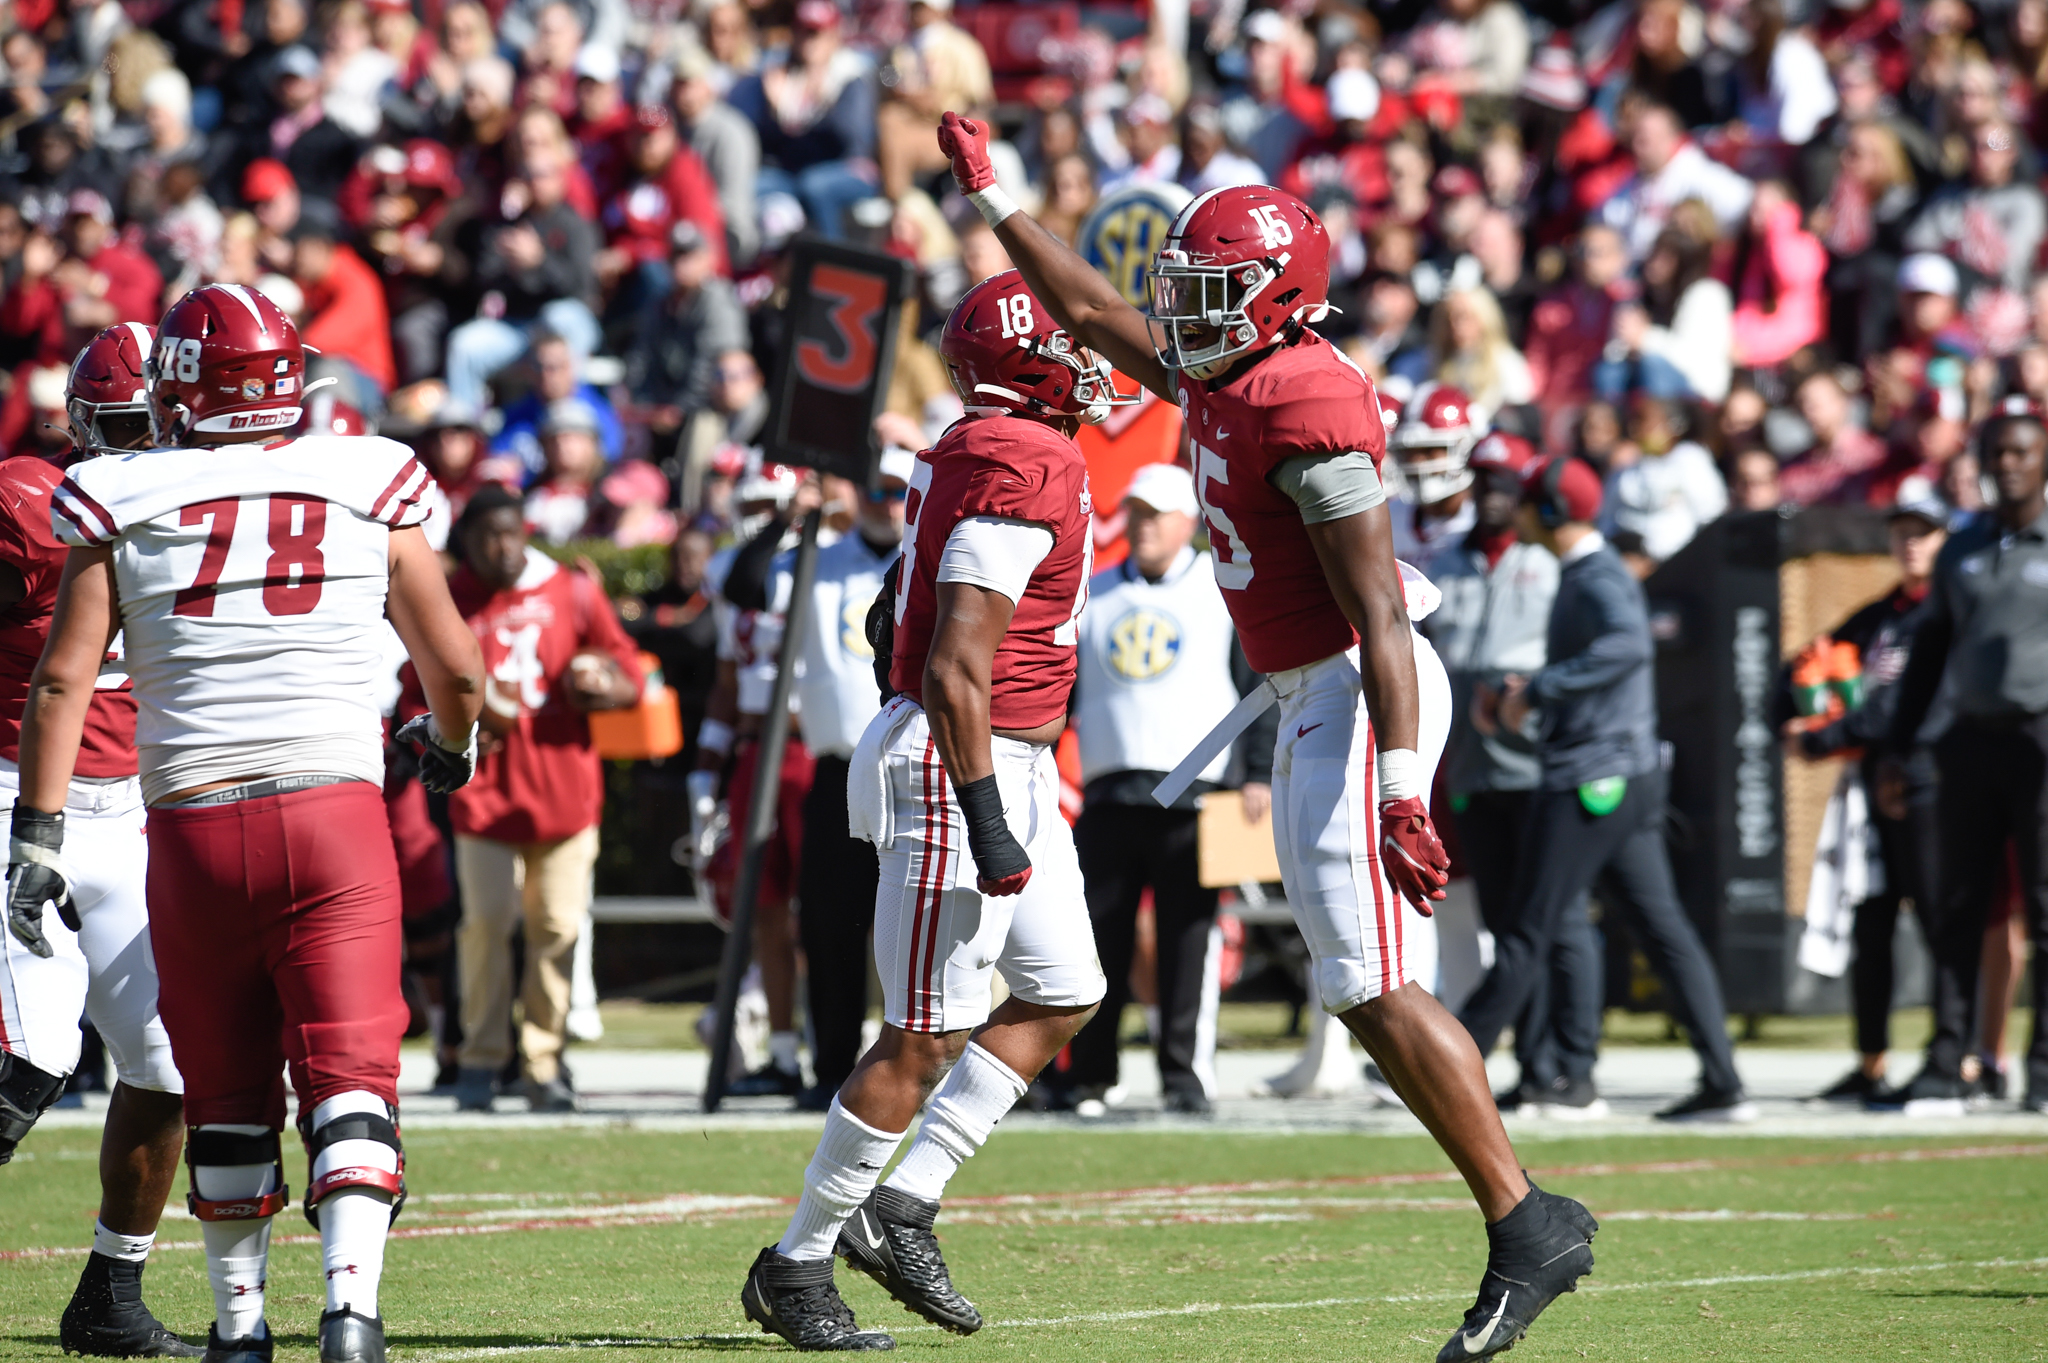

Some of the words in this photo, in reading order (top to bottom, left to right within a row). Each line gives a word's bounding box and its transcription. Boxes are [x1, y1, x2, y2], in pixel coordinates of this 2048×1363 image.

[1247, 204, 1294, 251] 15
[797, 263, 888, 387] 3
[997, 293, 1035, 339] 18
[158, 336, 203, 384] 78
[172, 492, 328, 617] 78
[1112, 611, 1179, 679] SEC
[213, 1204, 264, 1217] DONJOY
